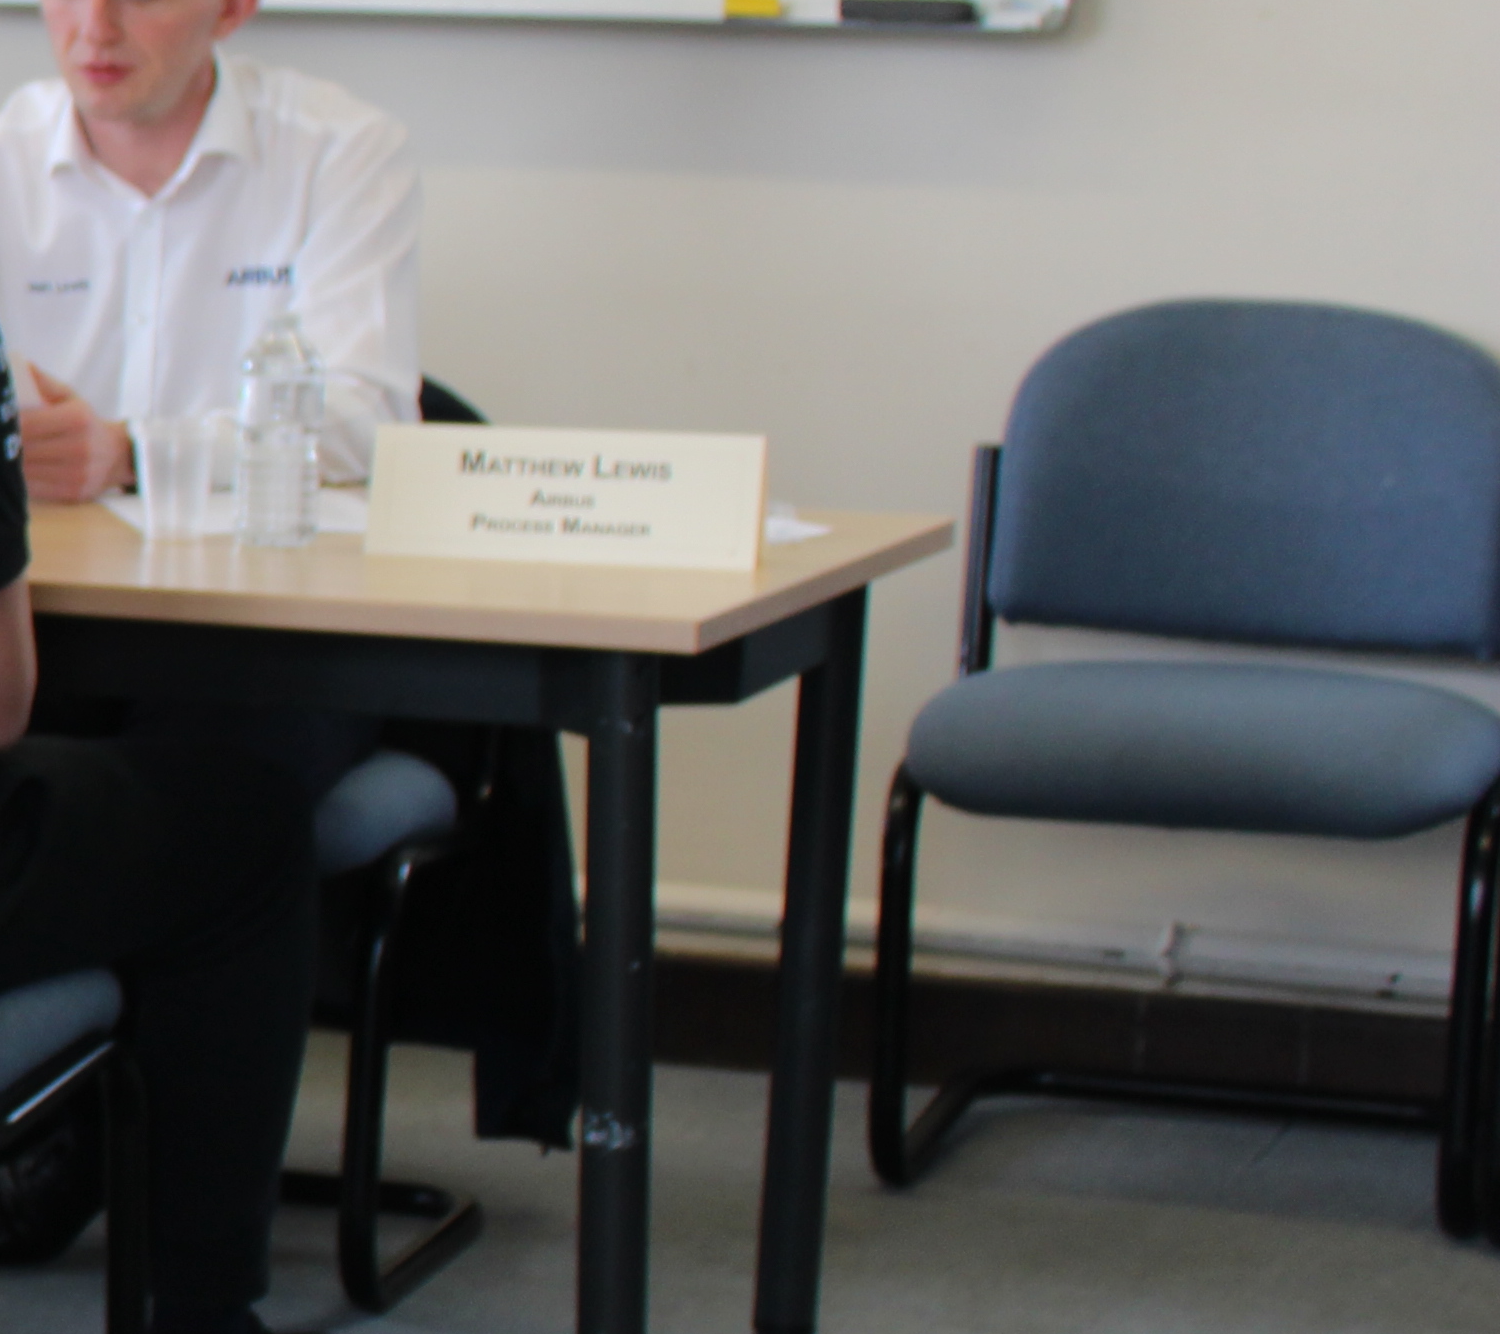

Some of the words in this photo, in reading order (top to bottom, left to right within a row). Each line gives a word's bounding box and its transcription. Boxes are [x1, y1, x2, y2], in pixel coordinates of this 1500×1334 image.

[460, 448, 585, 478] MATTHEW
[593, 454, 672, 482] LEWIS
[560, 516, 651, 538] MANAGER
